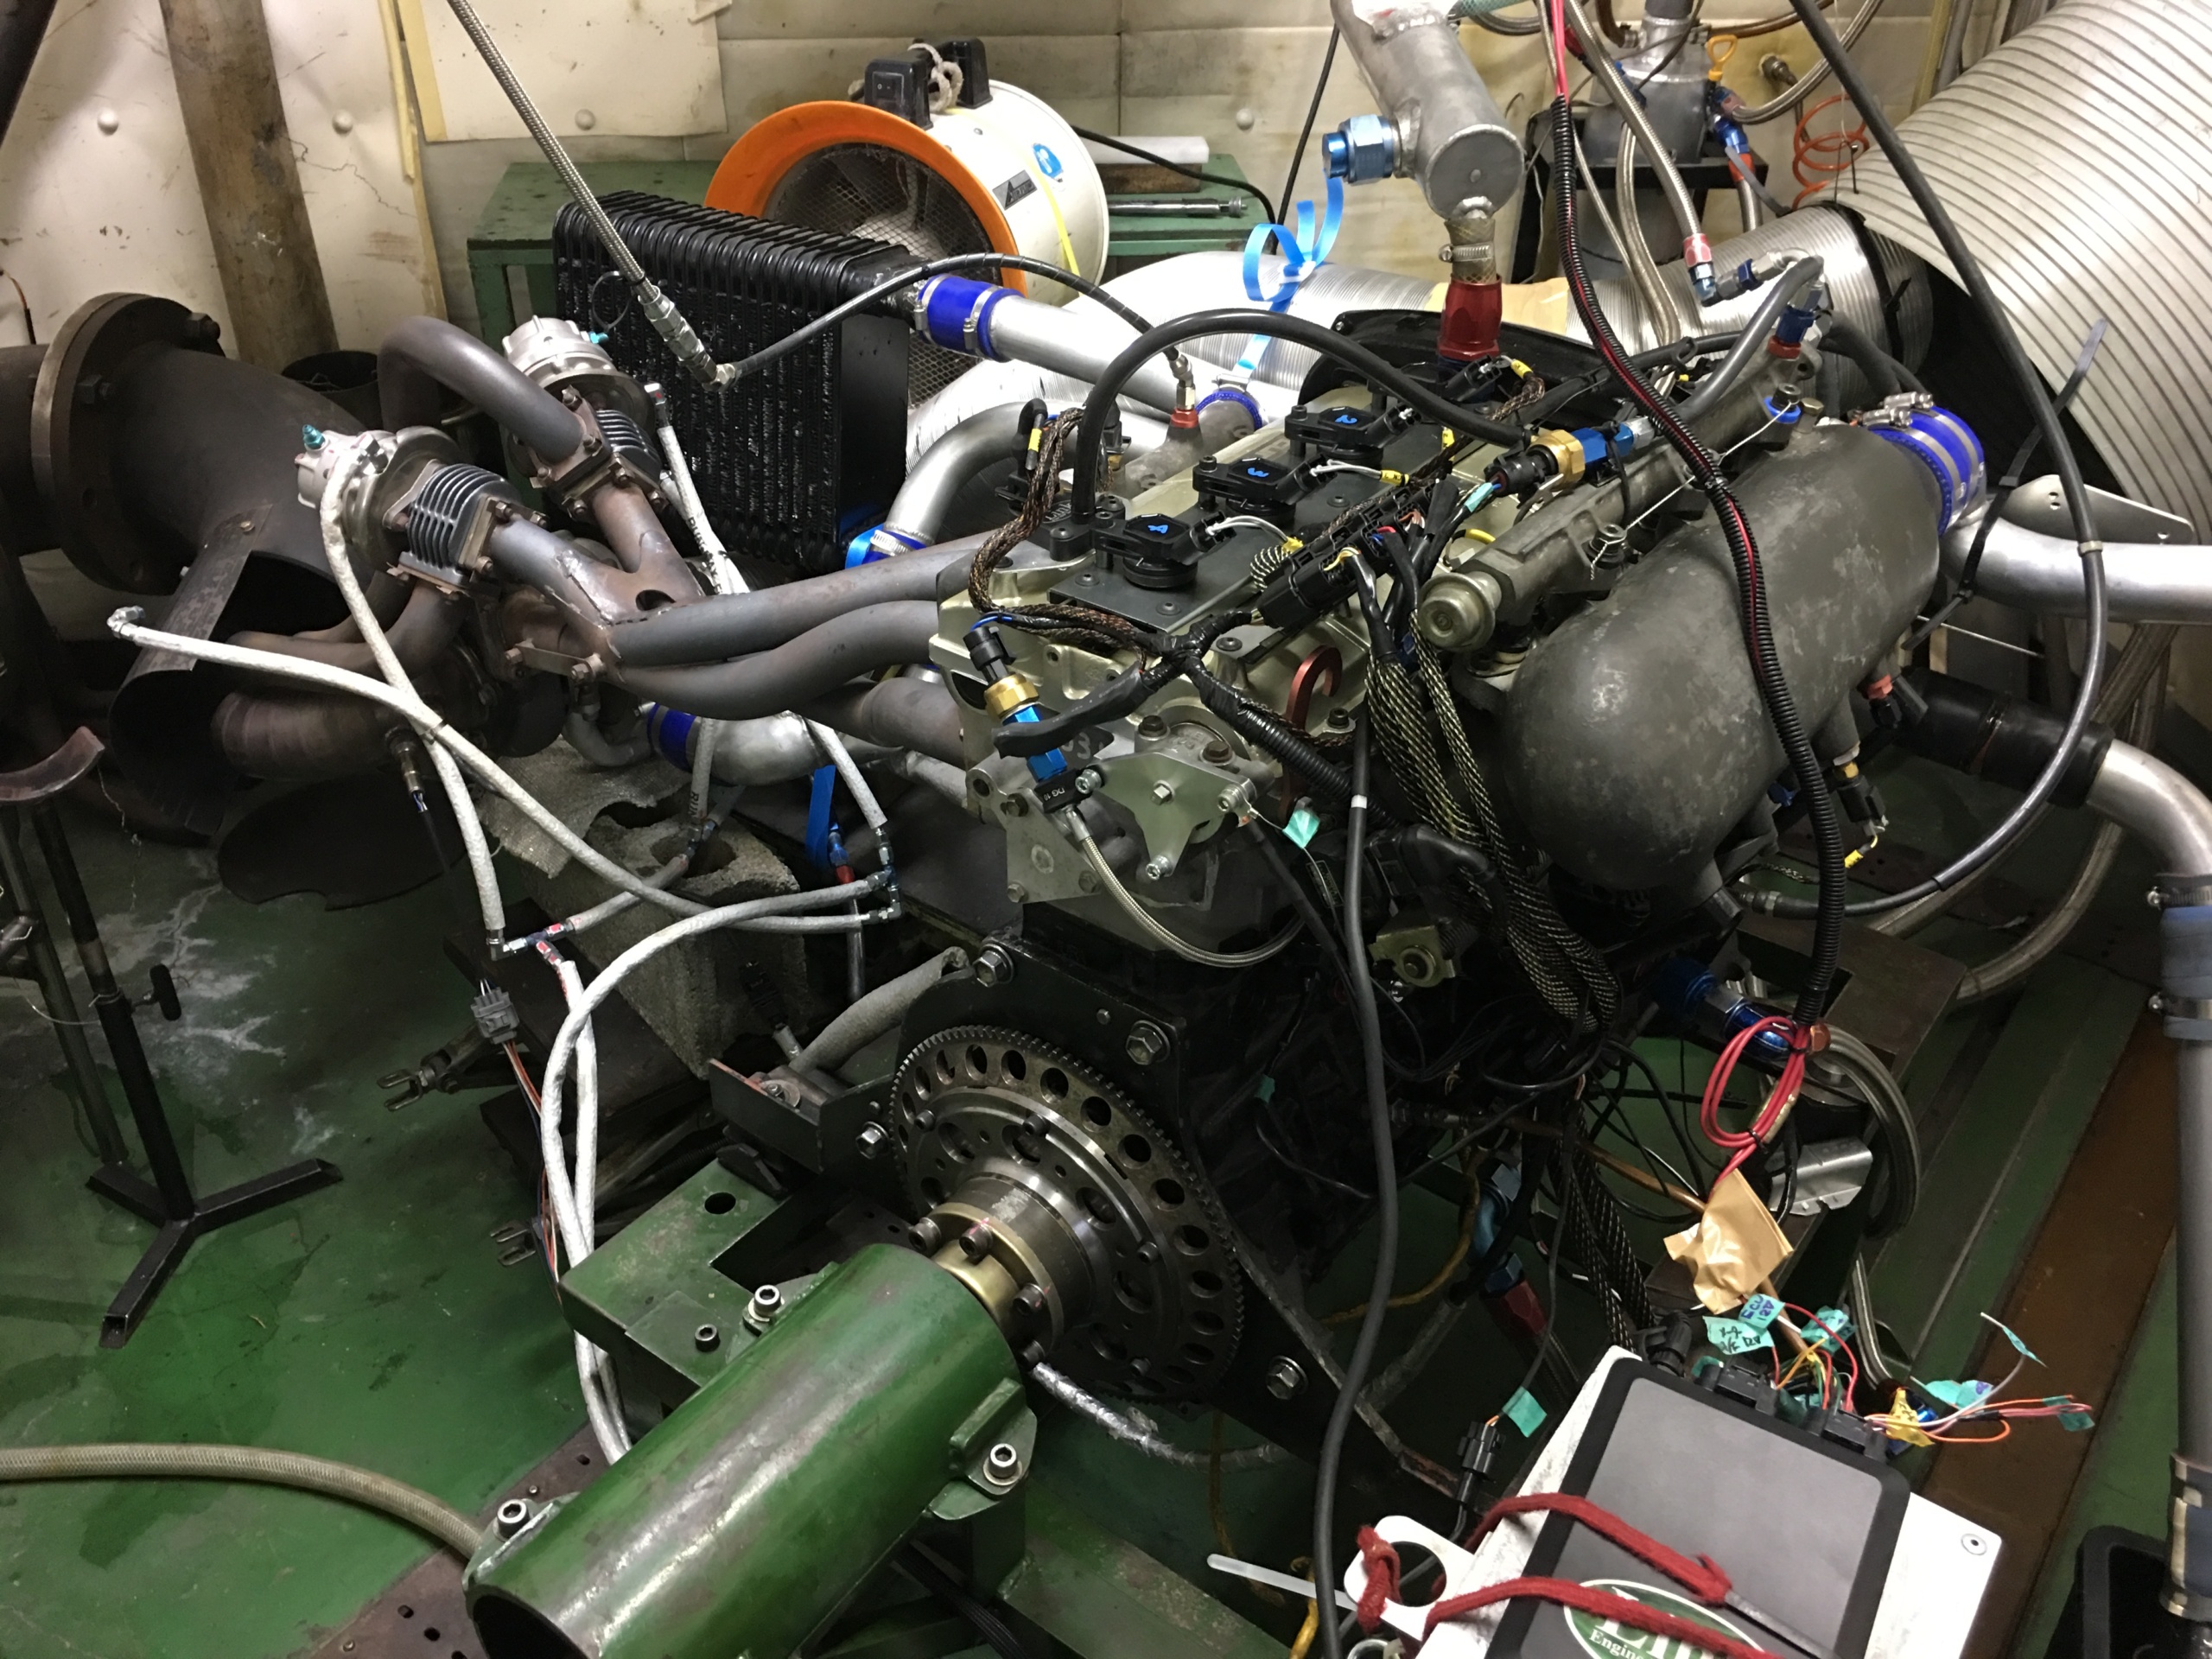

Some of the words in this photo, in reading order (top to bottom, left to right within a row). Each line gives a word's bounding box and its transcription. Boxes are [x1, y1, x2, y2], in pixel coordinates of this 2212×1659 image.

[1334, 415, 1357, 424] 2
[1247, 467, 1269, 478] 3
[1147, 524, 1168, 534] 4
[1741, 1294, 1764, 1319] ECU
